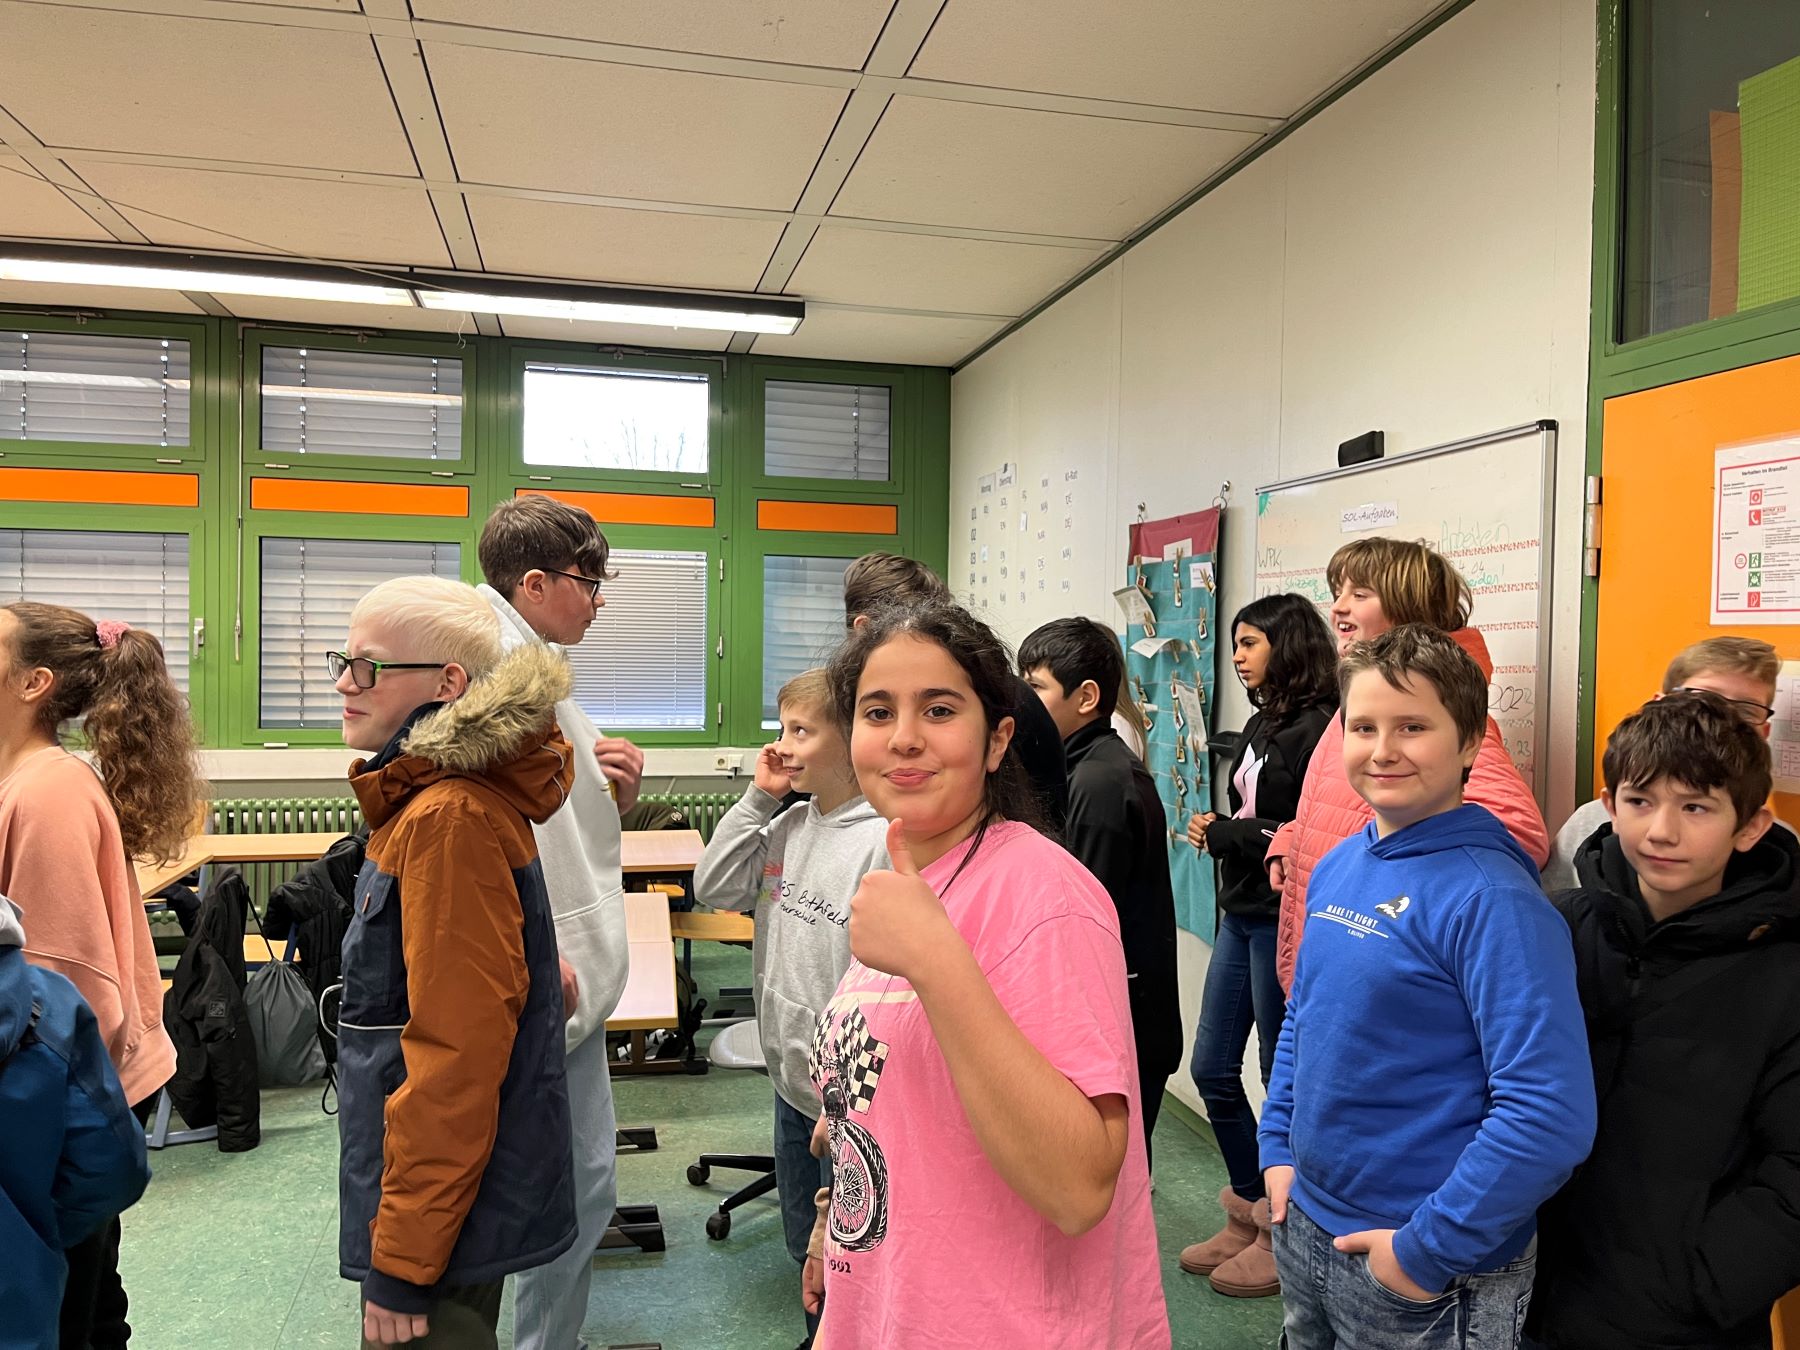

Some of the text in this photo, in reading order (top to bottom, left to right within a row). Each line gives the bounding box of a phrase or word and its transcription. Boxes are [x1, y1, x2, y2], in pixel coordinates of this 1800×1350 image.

[1342, 507, 1395, 526] SOL-Aufgaben
[798, 890, 849, 929] Bothfeld
[1326, 904, 1378, 928] MAKE IT RIGHT
